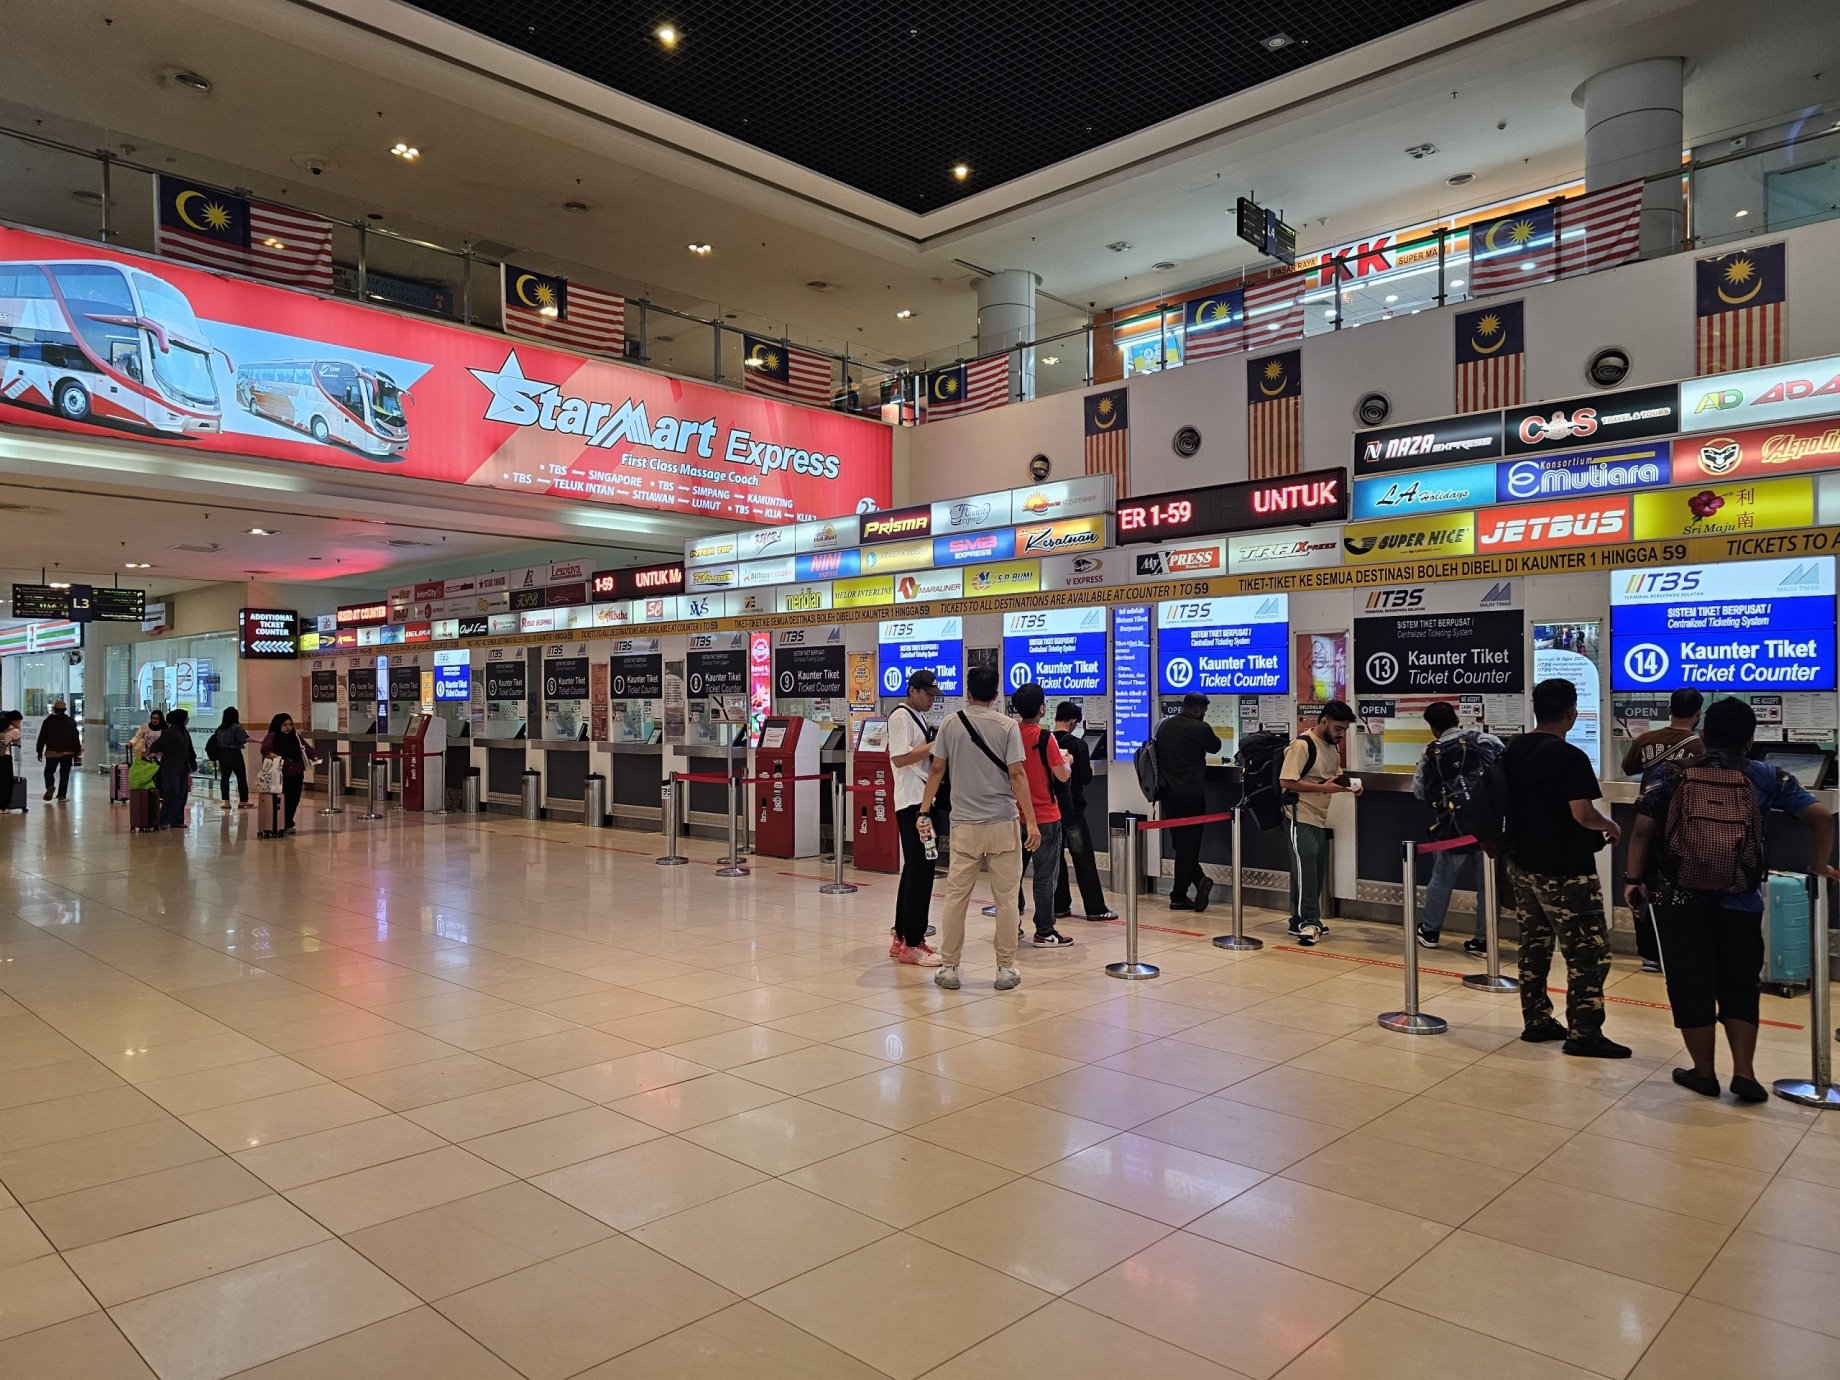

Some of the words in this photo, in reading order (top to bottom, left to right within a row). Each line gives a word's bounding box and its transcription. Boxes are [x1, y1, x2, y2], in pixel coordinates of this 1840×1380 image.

[1267, 224, 1275, 238] L4
[1273, 264, 1296, 277] PASAR
[1298, 259, 1316, 271] RAYA
[1320, 236, 1392, 287] KK
[1398, 251, 1424, 265] SUPER
[1601, 413, 1633, 425] TRAVEL
[1641, 407, 1671, 419] TOURS
[724, 428, 840, 480] Express
[1384, 433, 1435, 460] NAZA
[621, 453, 648, 469] First
[649, 458, 678, 474] Class
[680, 463, 727, 483] Massage
[729, 471, 759, 486] Coach
[1540, 456, 1593, 470] Konsortium
[549, 463, 568, 475] TBS
[588, 469, 643, 487] SINGAPORE
[658, 480, 674, 492] TBS
[692, 486, 730, 500] SIMPANG
[747, 495, 794, 509] KAMUNTING
[513, 472, 532, 484] TBS
[553, 478, 584, 493] TELUK
[585, 484, 615, 496] INTAN
[632, 489, 675, 505] SITIAWAN
[692, 499, 722, 511] LUMUT
[735, 504, 750, 515] TBS
[764, 508, 782, 519] KLIA
[1253, 479, 1338, 513] UNTUK
[1376, 481, 1421, 507] LA
[1418, 489, 1469, 502] Holidays
[1150, 500, 1192, 526] 1-59
[1480, 509, 1625, 545] JETBUS
[1683, 525, 1702, 535] Sri
[1703, 523, 1736, 534] Maju
[949, 535, 998, 552] SMB
[1726, 535, 1798, 556] TICKETS
[1802, 532, 1828, 550] TO
[954, 548, 992, 560] EXPRESS
[810, 551, 842, 573] NINI
[1238, 575, 1297, 592] TIKET-TIKET
[1300, 573, 1313, 587] KE
[1315, 571, 1353, 586] SEMUA
[1356, 566, 1415, 584] DESTINASI
[1417, 562, 1458, 578] BOLEH
[1462, 559, 1502, 576] DIBELI
[1505, 558, 1519, 572] DI
[1521, 553, 1587, 571] KAUNTER
[1601, 547, 1658, 565] HINGGA
[1662, 544, 1687, 560] 59
[595, 576, 613, 592] 1-59
[636, 571, 668, 588] UNTUK
[1066, 578, 1072, 586] V
[1073, 575, 1104, 585] EXPRESS
[835, 590, 856, 600] MELOR
[857, 587, 893, 597] INTERLINE
[918, 583, 961, 594] MARALINER
[73, 597, 90, 609] L3
[785, 587, 823, 610] meridian
[940, 601, 968, 613] TICKETS
[969, 601, 979, 611] TO
[979, 600, 994, 610] ALL
[994, 596, 1049, 609] DESTINATIONS
[1050, 595, 1066, 605] ARE
[1067, 591, 1112, 604] AVAILABLE
[1113, 590, 1125, 600] AT
[1126, 587, 1170, 600] COUNTER
[1179, 585, 1192, 595] TO
[1194, 582, 1209, 594] 59
[250, 613, 295, 622] ADDITIONAL
[361, 606, 387, 619] COUNTER
[771, 616, 789, 626] SEMUA
[789, 614, 816, 625] DESTINASI
[817, 612, 835, 623] BOLEH
[862, 608, 890, 619] KAUNTER
[895, 606, 919, 617] HINGGA
[919, 605, 930, 615] 59
[1667, 606, 1697, 618] SISTEM
[1698, 605, 1721, 617] TIKET
[1722, 604, 1766, 616] BERPUSAT
[260, 621, 285, 629] TICKET
[1397, 620, 1419, 629] SISTEM
[1420, 619, 1437, 628] TIKET
[1438, 618, 1471, 627] BERPUSAT
[1667, 617, 1707, 629] Centralized
[1708, 616, 1740, 628] Ticketing
[1741, 616, 1770, 628] System
[255, 628, 290, 636] COUNTER
[1397, 629, 1427, 639] Centralized
[1428, 629, 1452, 639] Ticketing
[1453, 628, 1473, 638] System
[1408, 650, 1467, 666] Kaunter
[1471, 648, 1509, 664] Tiket
[1681, 642, 1760, 660] Kaunter
[1764, 639, 1817, 658] Tiket
[1036, 662, 1073, 674] Kaunter
[1074, 660, 1099, 673] Tiket
[1199, 656, 1246, 670] Kaunter
[1247, 655, 1279, 669] Tiket
[1374, 657, 1391, 678] 13
[1634, 651, 1658, 675] 14
[626, 674, 647, 683] Kaunter
[647, 674, 659, 683] Tiket
[705, 672, 727, 682] Kaunter
[727, 672, 742, 681] Tiket
[797, 670, 822, 680] Kaunter
[823, 669, 840, 679] Tiket
[936, 665, 957, 677] Tiket
[1014, 668, 1025, 684] 11
[1171, 663, 1187, 682] 12
[1409, 670, 1449, 685] Ticket
[1453, 669, 1511, 684] Counter
[1681, 664, 1736, 682] Ticket
[1740, 662, 1820, 682] Counter
[784, 675, 790, 688] 9
[798, 682, 815, 692] Ticket
[816, 682, 840, 692] Counter
[1036, 676, 1062, 689] Ticket
[1063, 676, 1100, 689] Counter
[1199, 673, 1232, 687] Ticket
[1234, 672, 1280, 687] Counter
[641, 685, 659, 693] Counter
[1361, 706, 1387, 715] OPEN
[1625, 707, 1658, 717] OPEN
